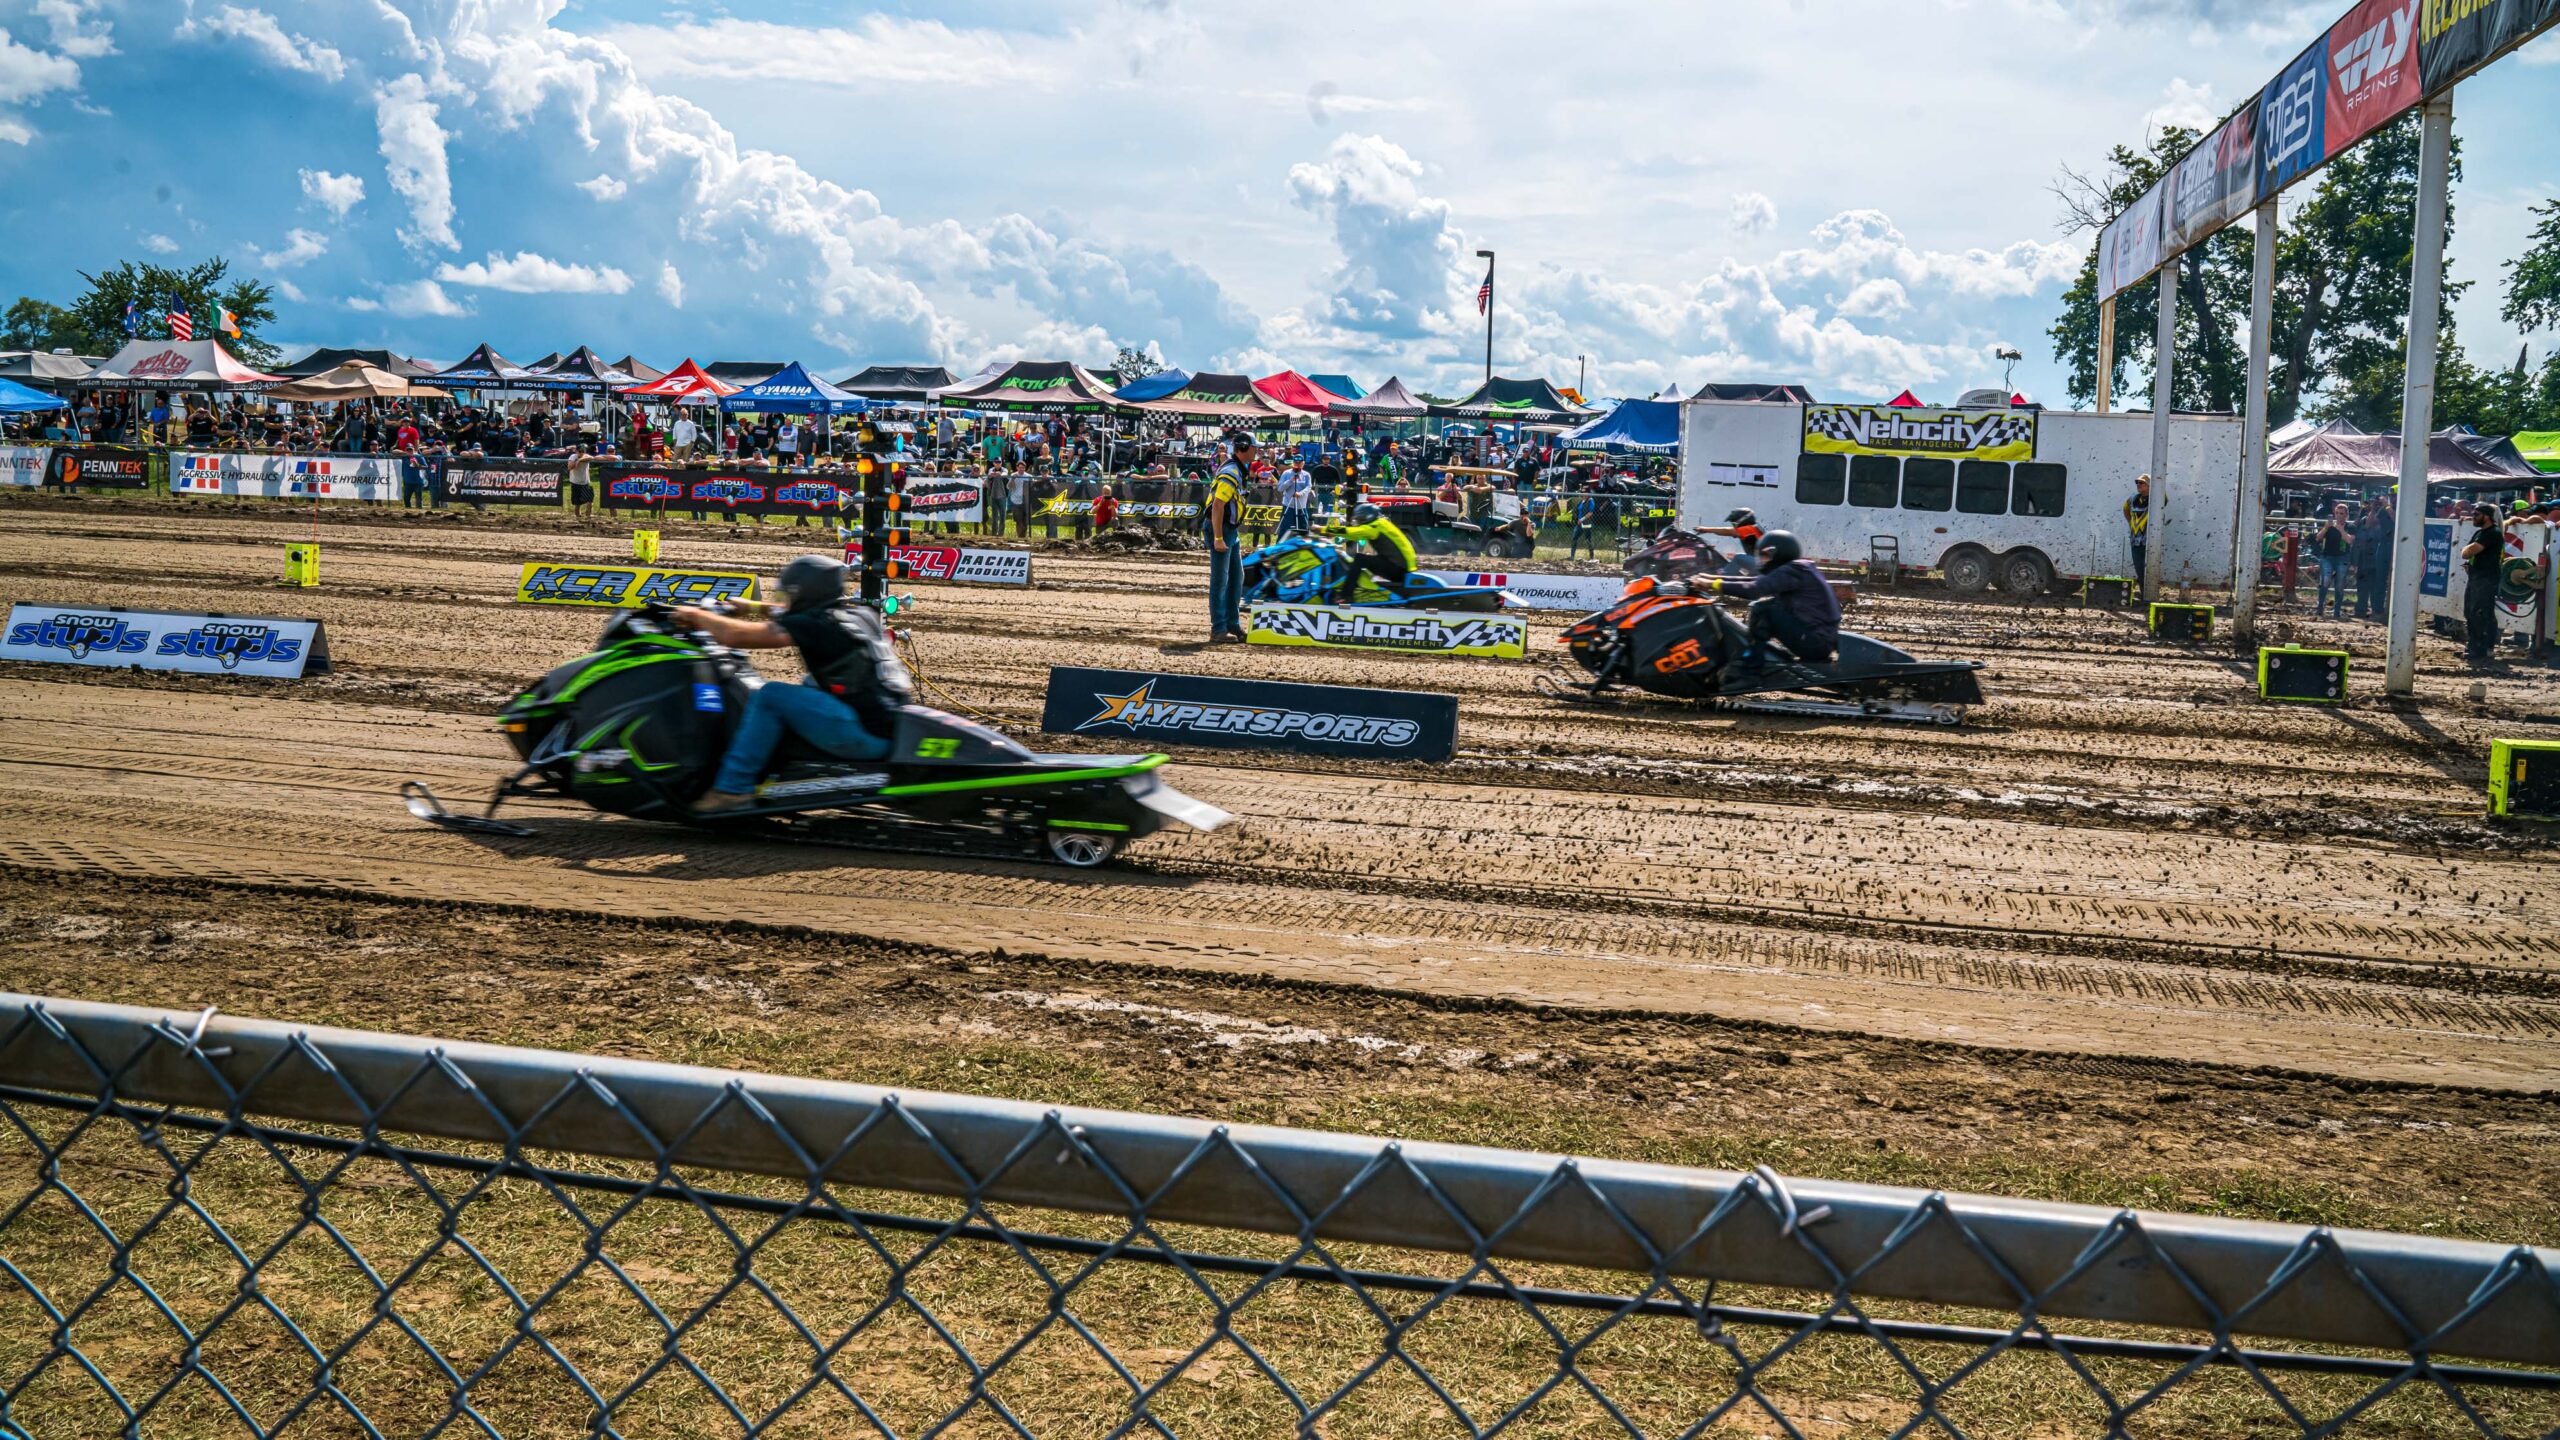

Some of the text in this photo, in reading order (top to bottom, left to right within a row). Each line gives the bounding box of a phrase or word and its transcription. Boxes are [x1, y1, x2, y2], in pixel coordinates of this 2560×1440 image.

[2333, 0, 2420, 96] FLY
[2346, 69, 2399, 112] RACING
[1001, 376, 1073, 390] ARCTIC CAT
[767, 386, 812, 394] YAMAHA
[1174, 391, 1253, 404] ARCTIC CAT
[1838, 408, 2000, 449] Velocity
[1571, 439, 1607, 450] YAMAHA
[1636, 444, 1670, 455] YAMAHA
[1869, 438, 1893, 446] RACE
[1902, 440, 1967, 449] MANAGEMENT
[82, 460, 142, 473] PENNTEK
[178, 469, 278, 481] AGGRESSIVE HYDRAULICS
[288, 473, 390, 485] AGGRESSIVE HYDRAULICS
[461, 489, 558, 498] PERFORMANCE ENGINES
[612, 480, 681, 498] studs
[693, 482, 763, 500] studs
[955, 490, 978, 502] USA
[1051, 501, 1200, 517] HYPSPORTS
[962, 555, 1027, 567] RACING
[920, 569, 944, 577] bros
[957, 567, 1026, 577] PRODUCTS
[524, 567, 752, 600] KCR KCR
[1516, 588, 1578, 599] HYDRAULICS
[55, 614, 117, 628] snow
[203, 623, 268, 637] snow
[1290, 609, 1485, 648] Velocity
[8, 619, 150, 653] studs
[1328, 635, 1356, 643] RACE
[1366, 638, 1443, 648] MANAGEMENT
[156, 629, 301, 663] studs
[1117, 700, 1418, 745] HYPERSPORTS
